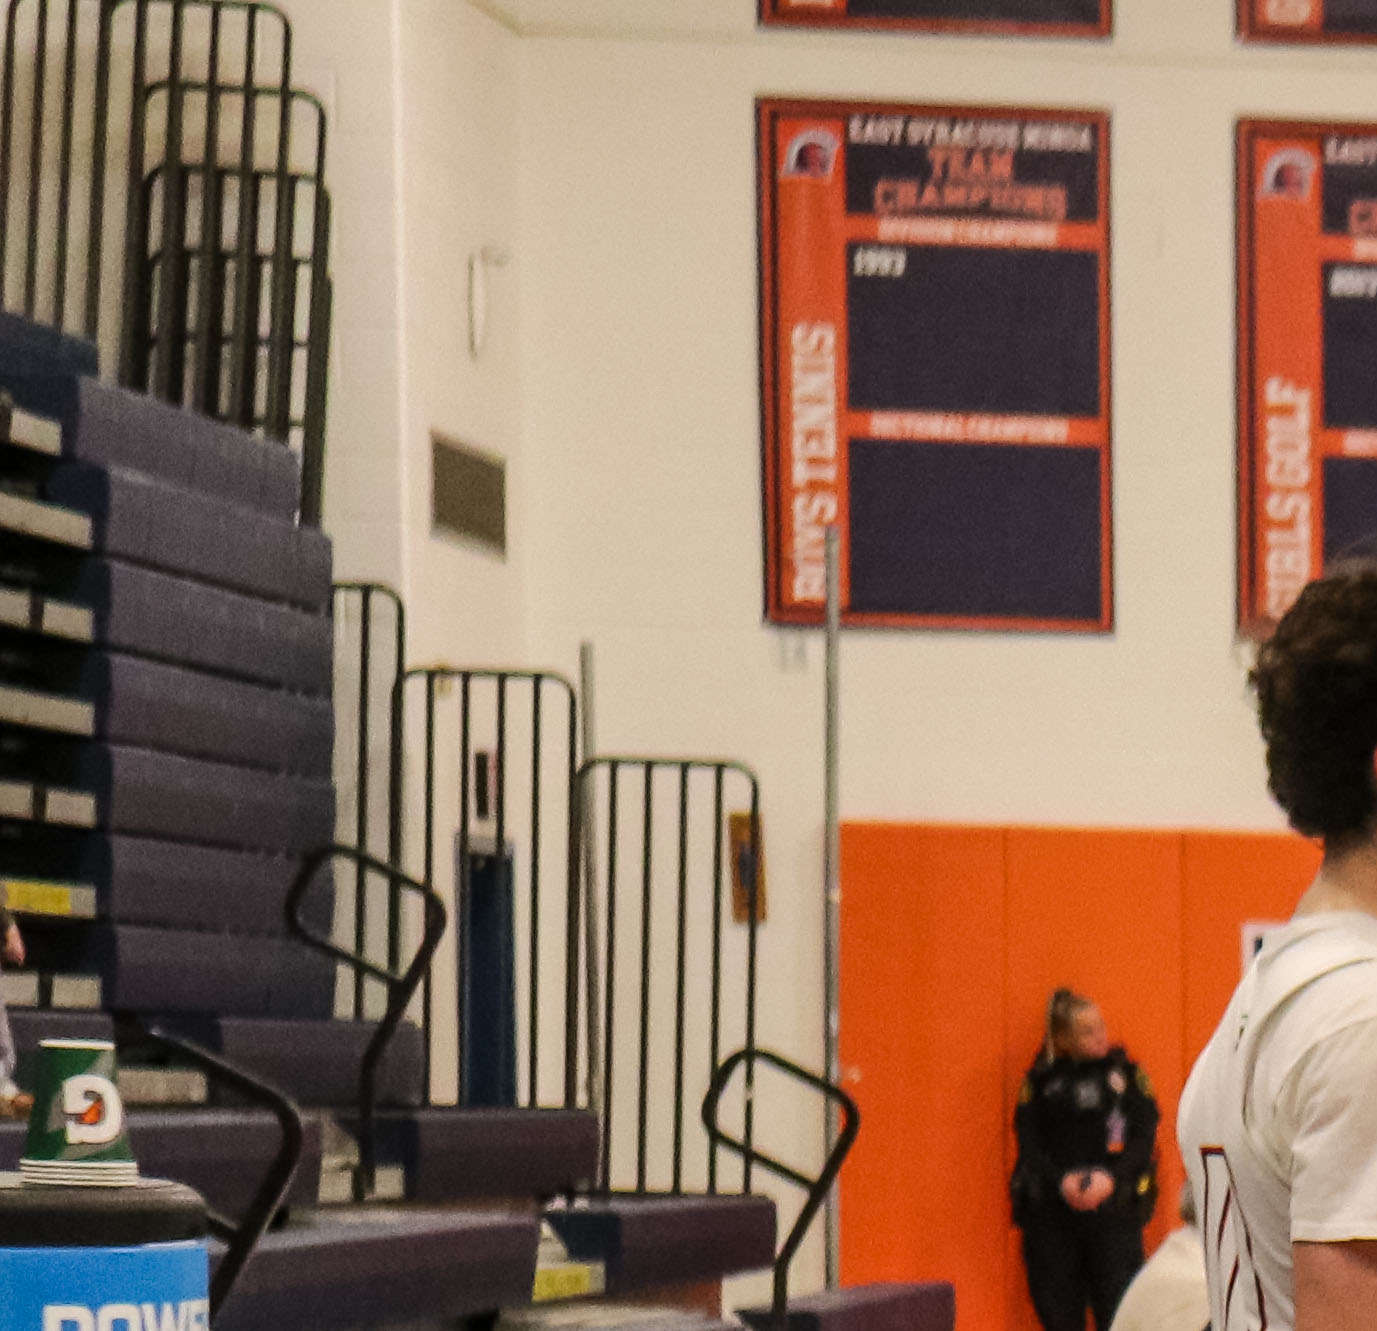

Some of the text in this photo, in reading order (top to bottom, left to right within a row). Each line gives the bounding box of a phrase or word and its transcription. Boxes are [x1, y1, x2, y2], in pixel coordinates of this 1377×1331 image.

[874, 178, 1066, 222] CHAMPIONS
[928, 147, 1014, 185] TEAM
[791, 322, 838, 488] TENNIS
[1263, 377, 1312, 489] GOLF
